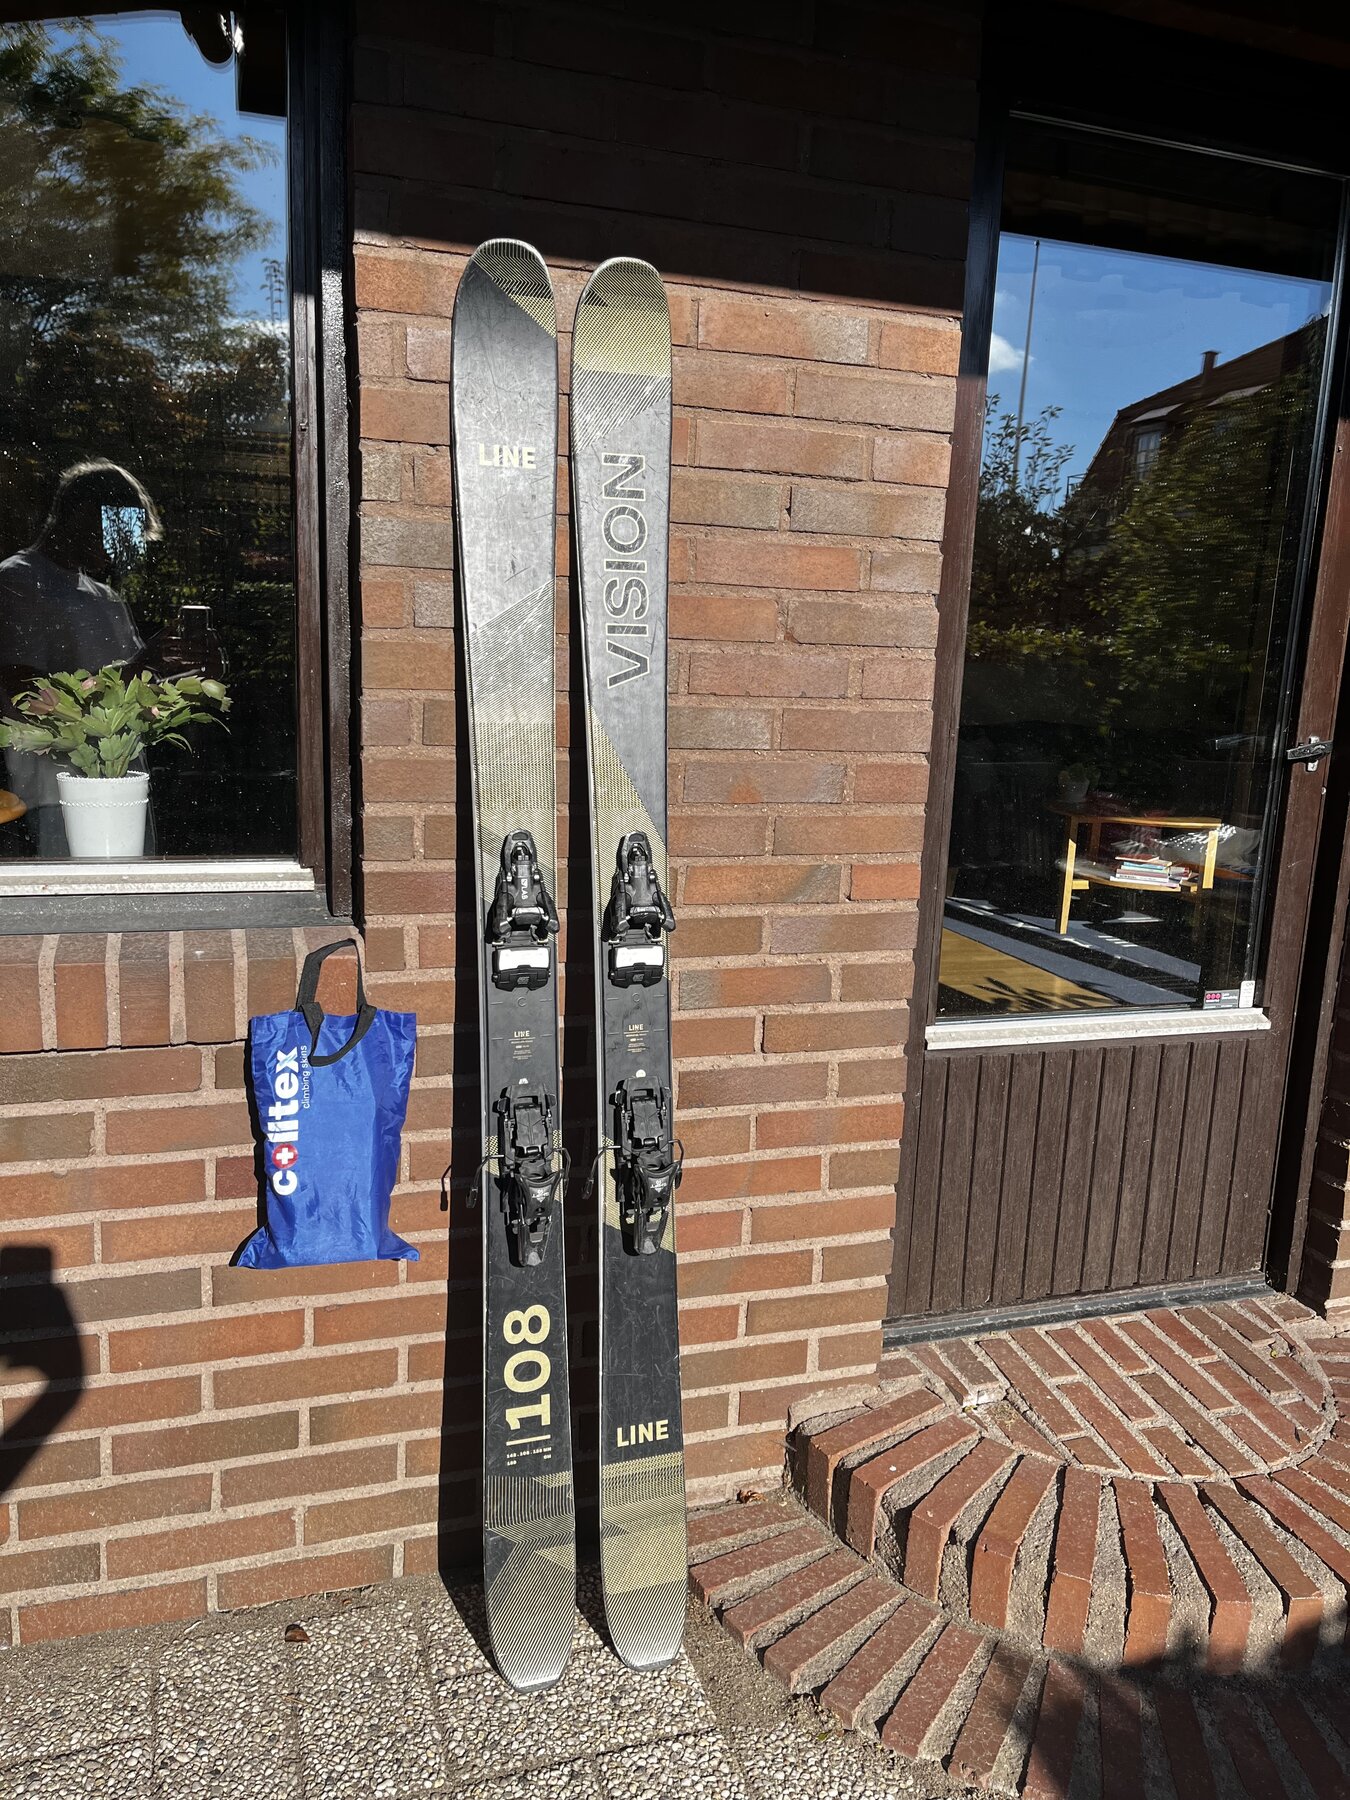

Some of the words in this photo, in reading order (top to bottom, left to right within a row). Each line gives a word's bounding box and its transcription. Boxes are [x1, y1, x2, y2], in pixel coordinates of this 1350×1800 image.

[478, 444, 537, 469] LINE
[601, 452, 651, 690] VISION
[513, 1030, 530, 1038] LINE
[628, 1023, 644, 1031] LINE
[299, 1045, 309, 1069] skins
[300, 1070, 311, 1109] climbing
[502, 1304, 552, 1431] 108
[616, 1418, 670, 1448] LINE
